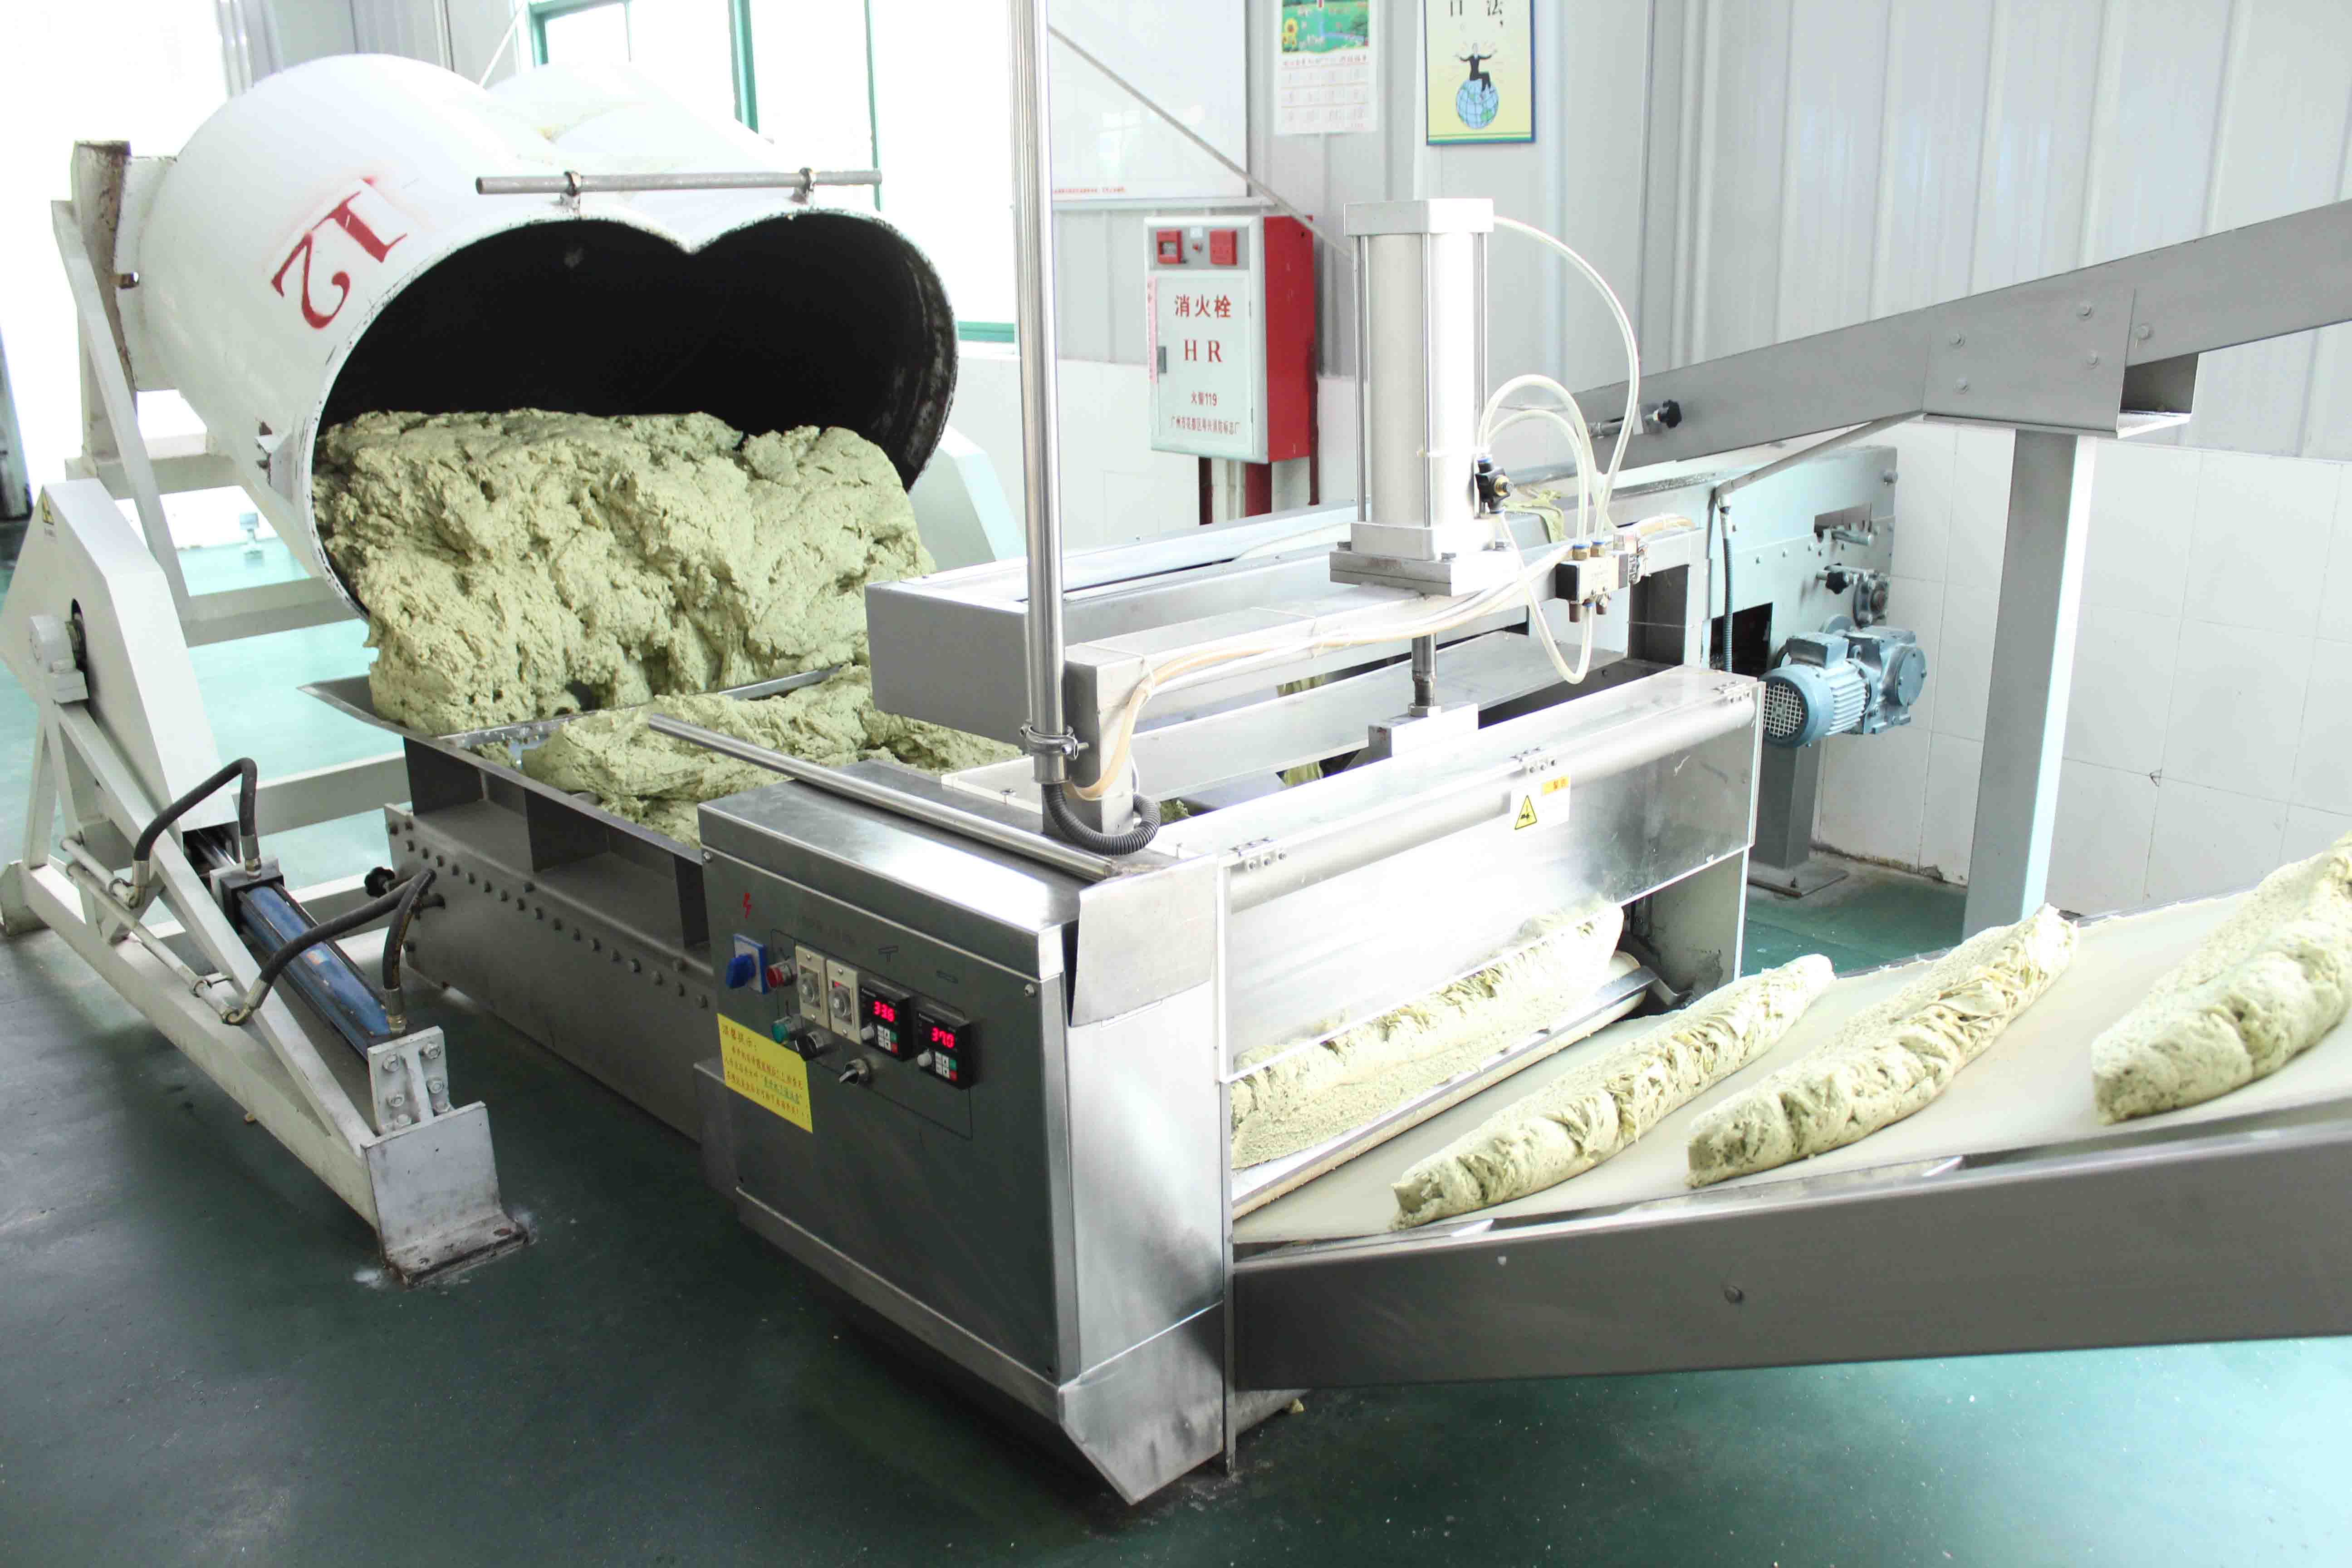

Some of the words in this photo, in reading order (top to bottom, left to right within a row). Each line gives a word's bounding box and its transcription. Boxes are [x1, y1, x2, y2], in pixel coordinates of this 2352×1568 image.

[271, 190, 408, 330] 12
[1174, 294, 1231, 318] 消火栓
